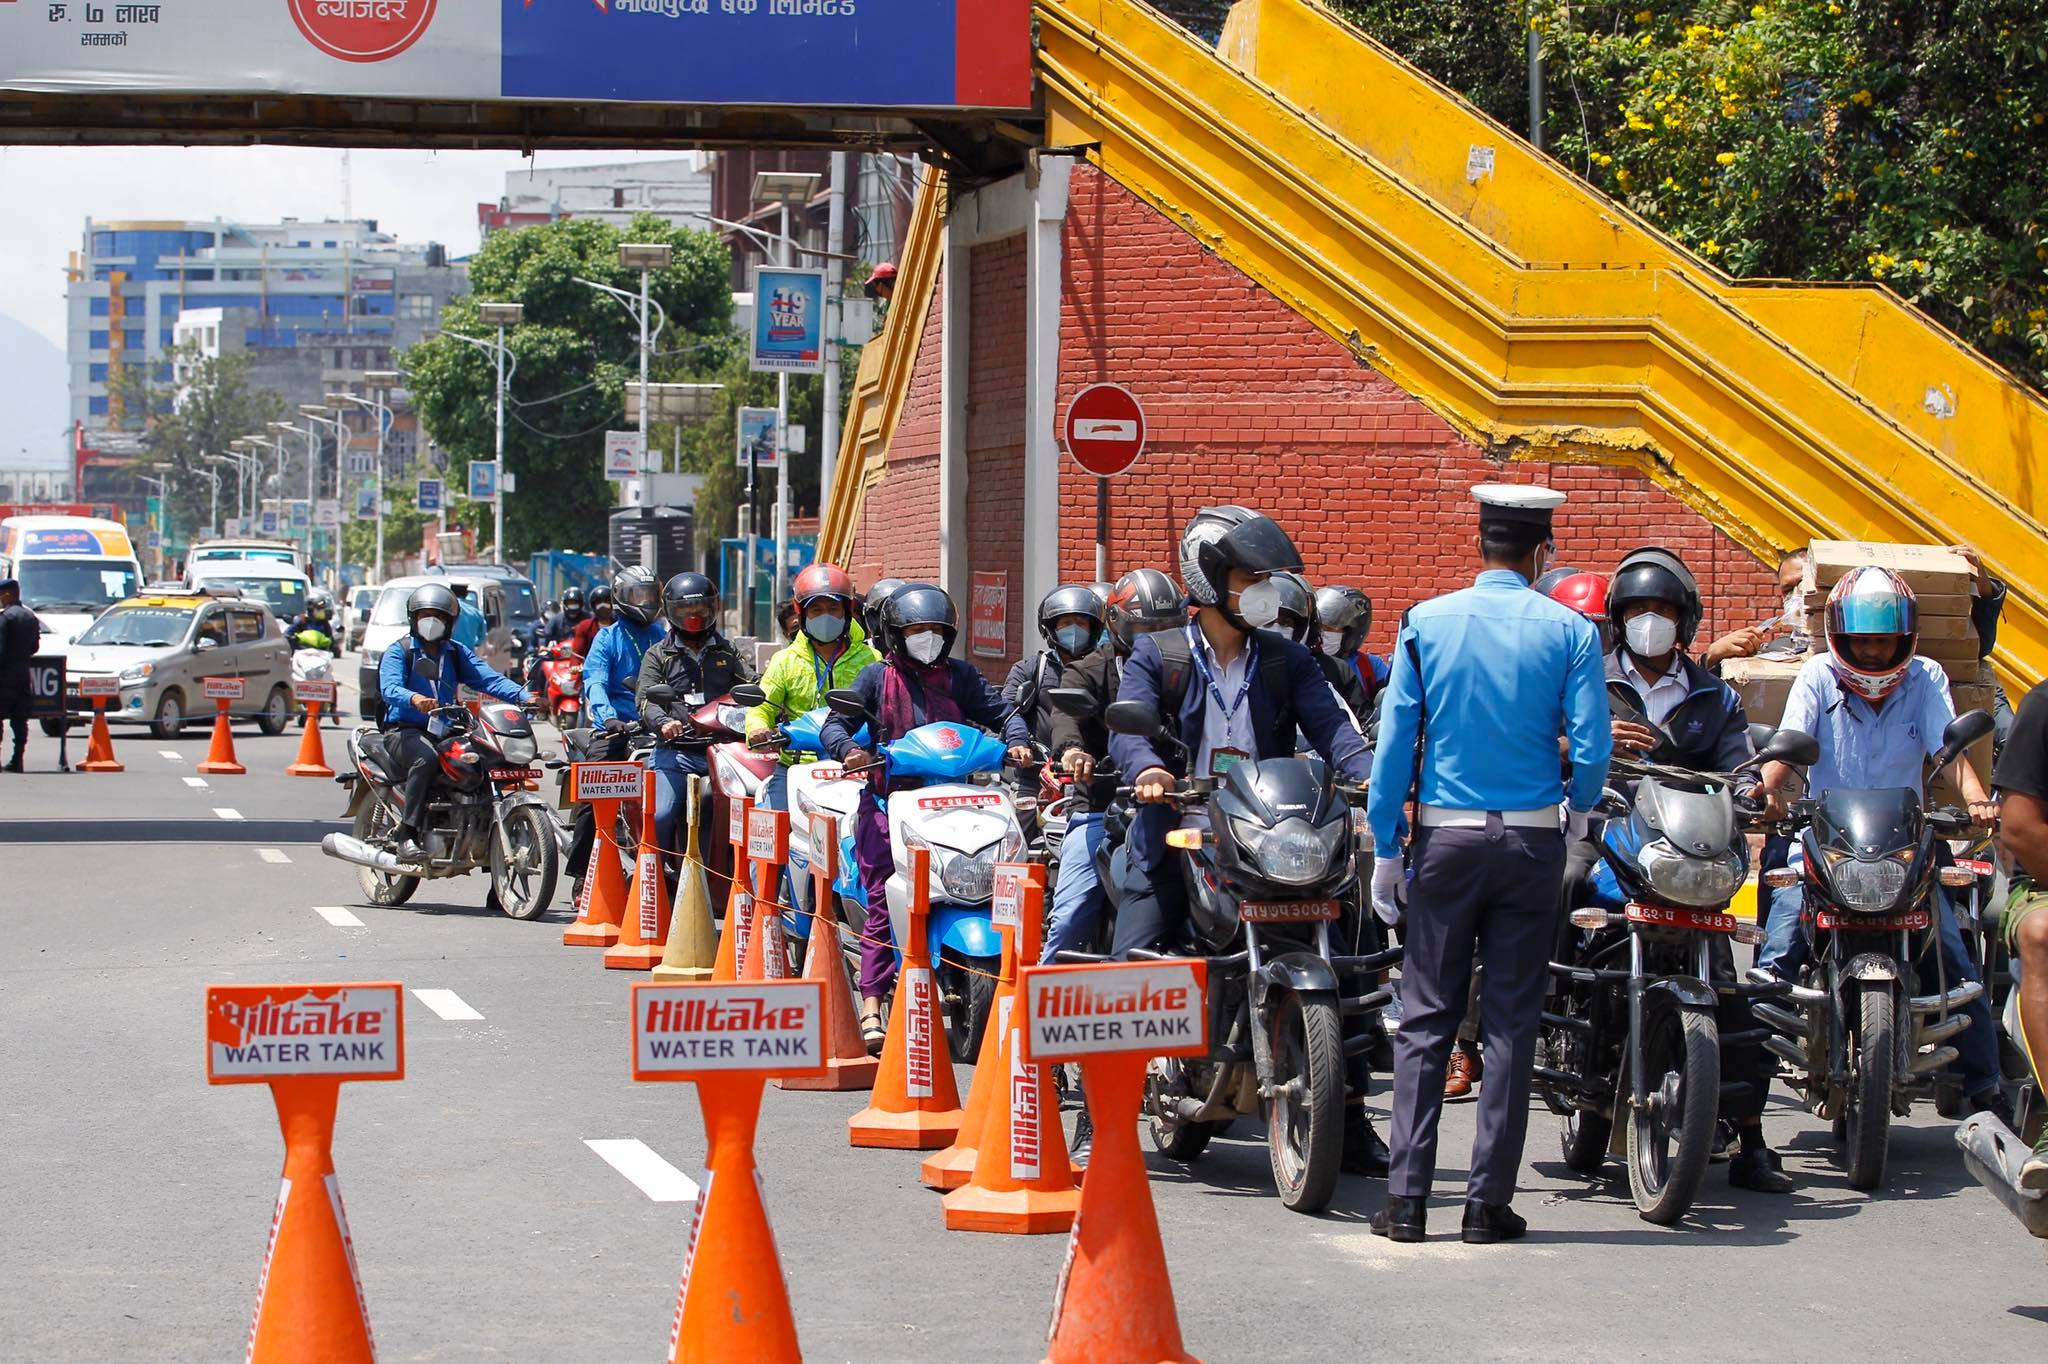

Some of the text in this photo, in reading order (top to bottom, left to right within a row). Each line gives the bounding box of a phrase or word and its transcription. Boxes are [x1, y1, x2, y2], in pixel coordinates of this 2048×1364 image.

[115, 5, 161, 23] लाख
[580, 769, 637, 784] Hilltake
[582, 784, 638, 795] WATER TANK
[641, 862, 657, 932] Hilltake
[1037, 979, 1188, 1019] Hilltake
[646, 998, 806, 1033] Hilltake
[909, 980, 931, 1088] Hilltake
[1042, 1017, 1192, 1043] WATER TANK
[225, 1041, 384, 1063] WATER TANK
[650, 1037, 808, 1059] WATER TANK
[1013, 1064, 1038, 1168] Hilltak
